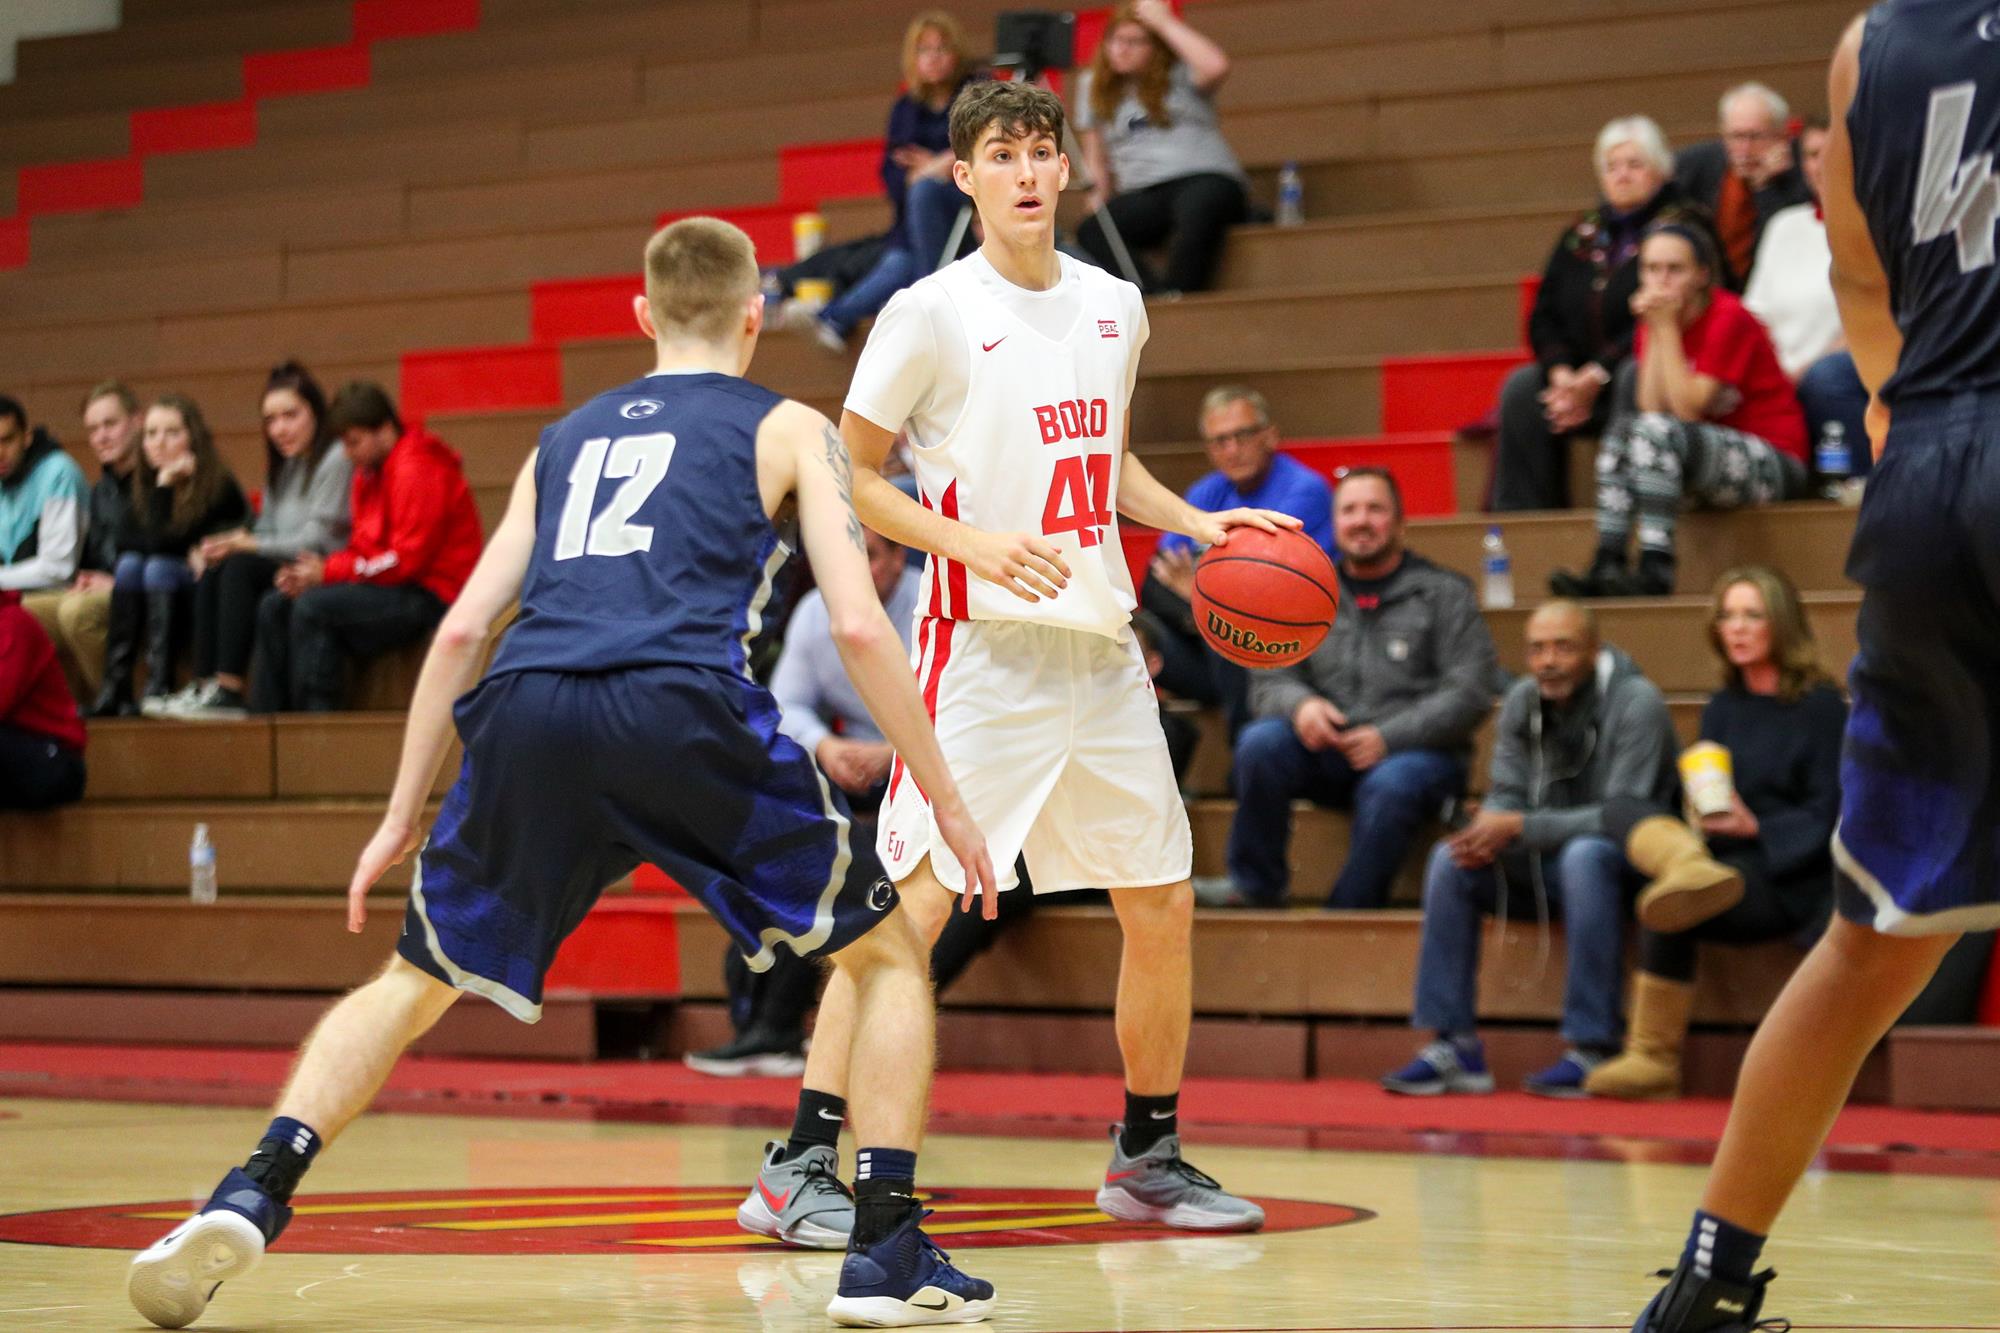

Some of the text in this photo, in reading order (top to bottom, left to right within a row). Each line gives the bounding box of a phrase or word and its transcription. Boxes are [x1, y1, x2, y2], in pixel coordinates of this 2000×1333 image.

[1911, 80, 2000, 274] 4
[1033, 398, 1107, 445] BORO
[554, 431, 676, 561] 12
[1208, 609, 1301, 655] Wilson
[888, 831, 905, 862] EU
